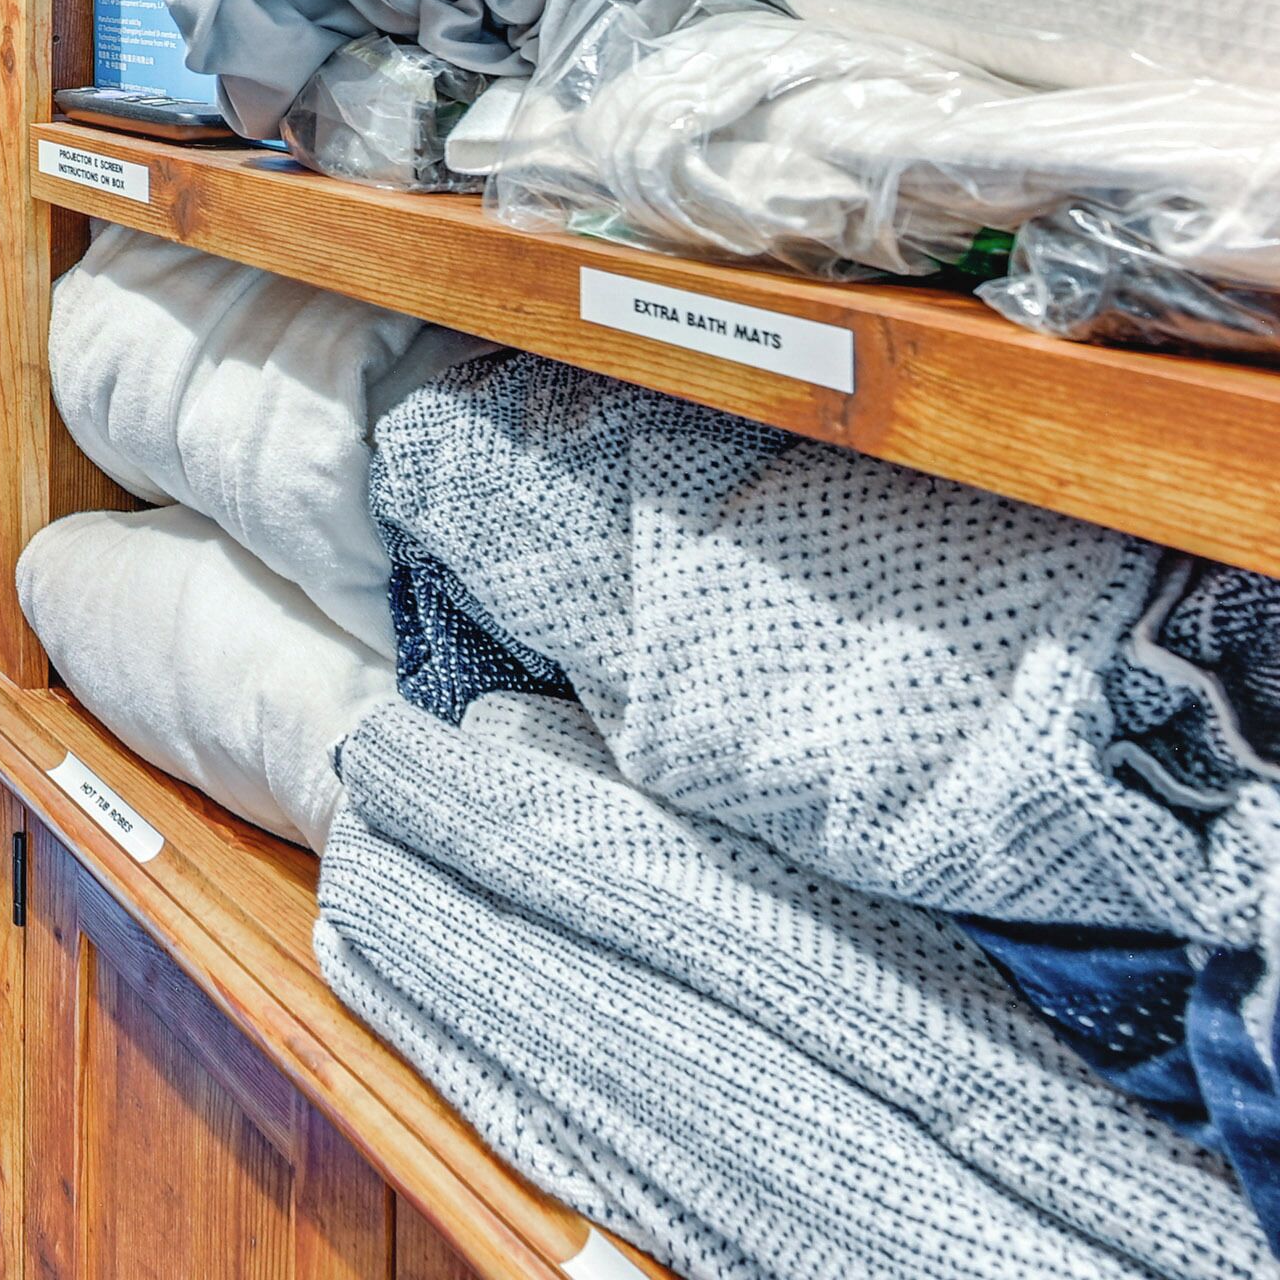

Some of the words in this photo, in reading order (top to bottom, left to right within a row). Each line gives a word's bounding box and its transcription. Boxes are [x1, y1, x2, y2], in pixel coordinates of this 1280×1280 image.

[58, 163, 99, 182] INSTRUCTIONS
[100, 175, 110, 185] ON
[112, 178, 125, 189] BOX
[59, 149, 92, 165] PROJECTOR
[100, 160, 123, 174] SCREEN
[633, 298, 680, 323] EXTRA
[687, 312, 727, 335] BATH
[734, 324, 782, 349] MATS
[80, 782, 97, 798] HOT
[96, 796, 110, 811] TUB
[108, 809, 133, 833] ROBES
